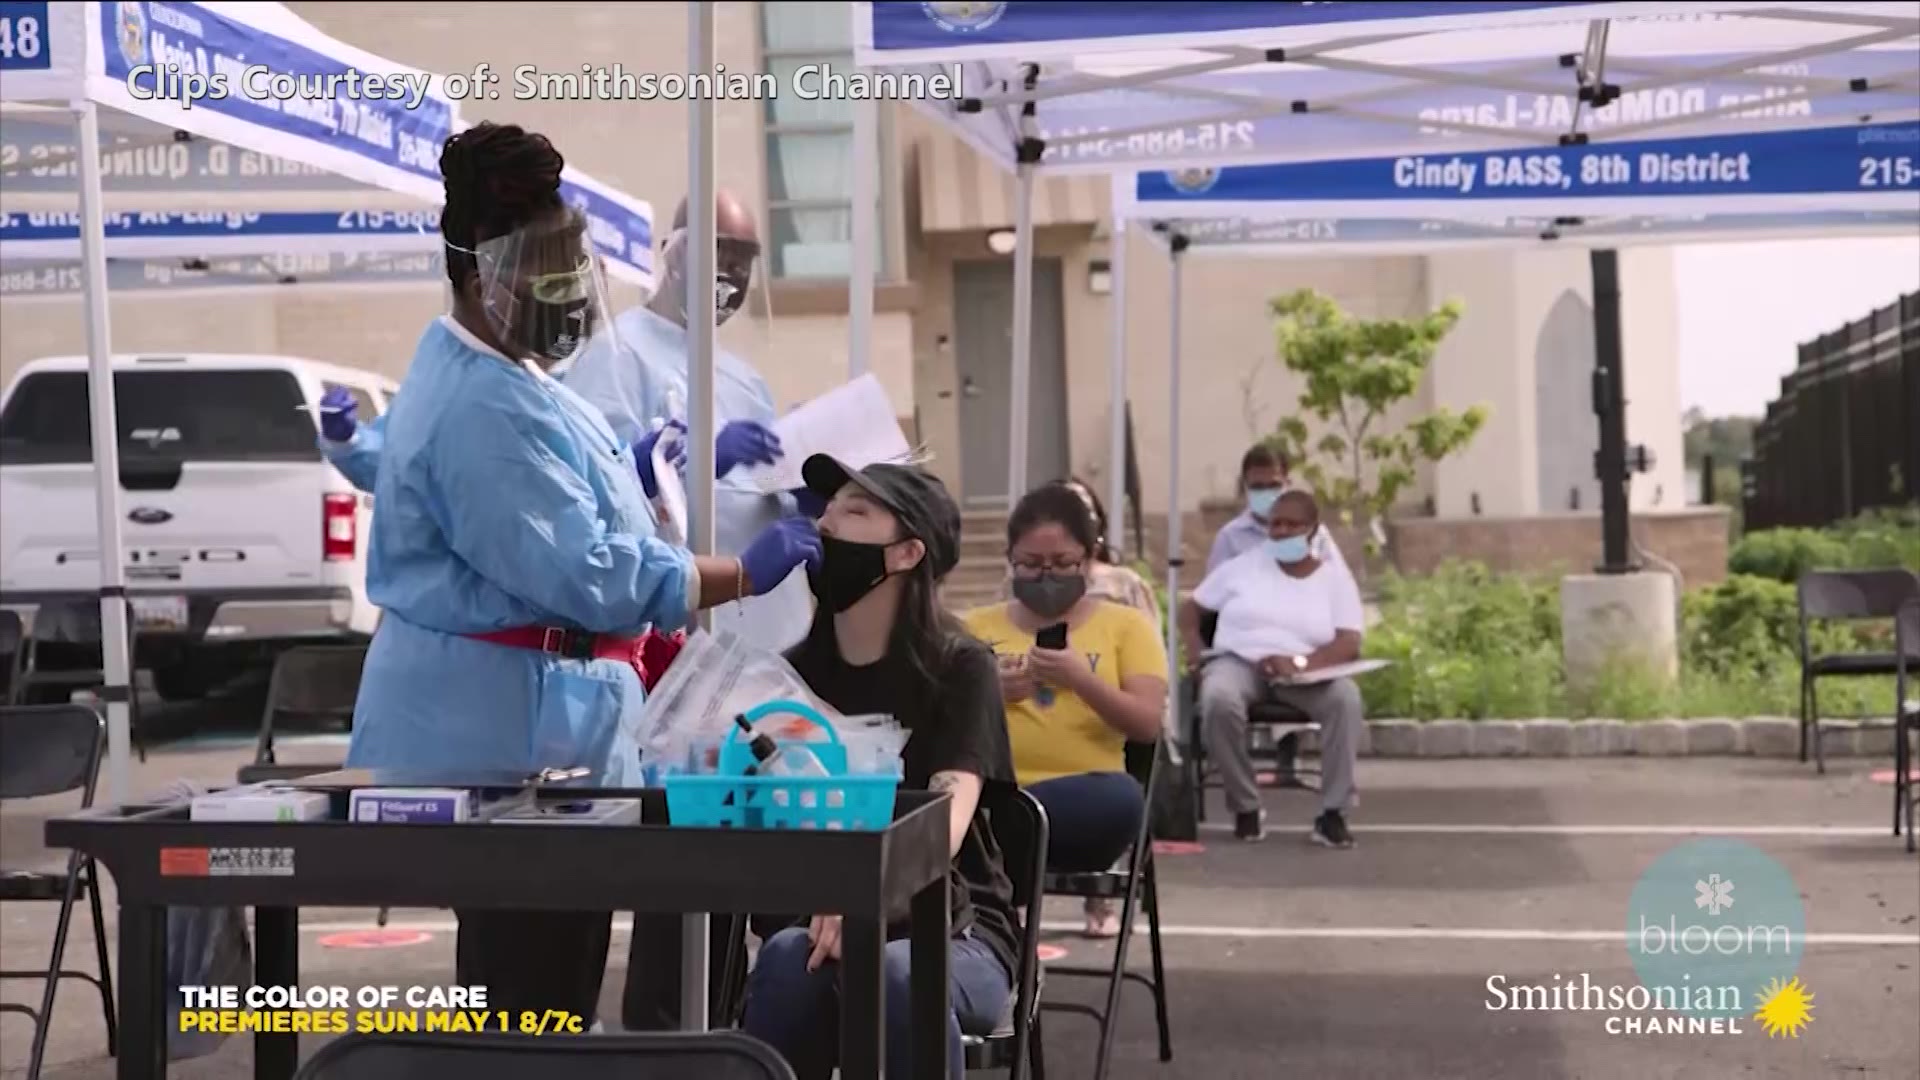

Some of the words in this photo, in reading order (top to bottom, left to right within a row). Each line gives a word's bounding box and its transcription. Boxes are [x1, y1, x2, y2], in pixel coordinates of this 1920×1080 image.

[1393, 155, 1478, 193] Cindy
[1484, 155, 1572, 190] BASS,
[1580, 152, 1631, 185] 8th
[1638, 150, 1751, 184] District
